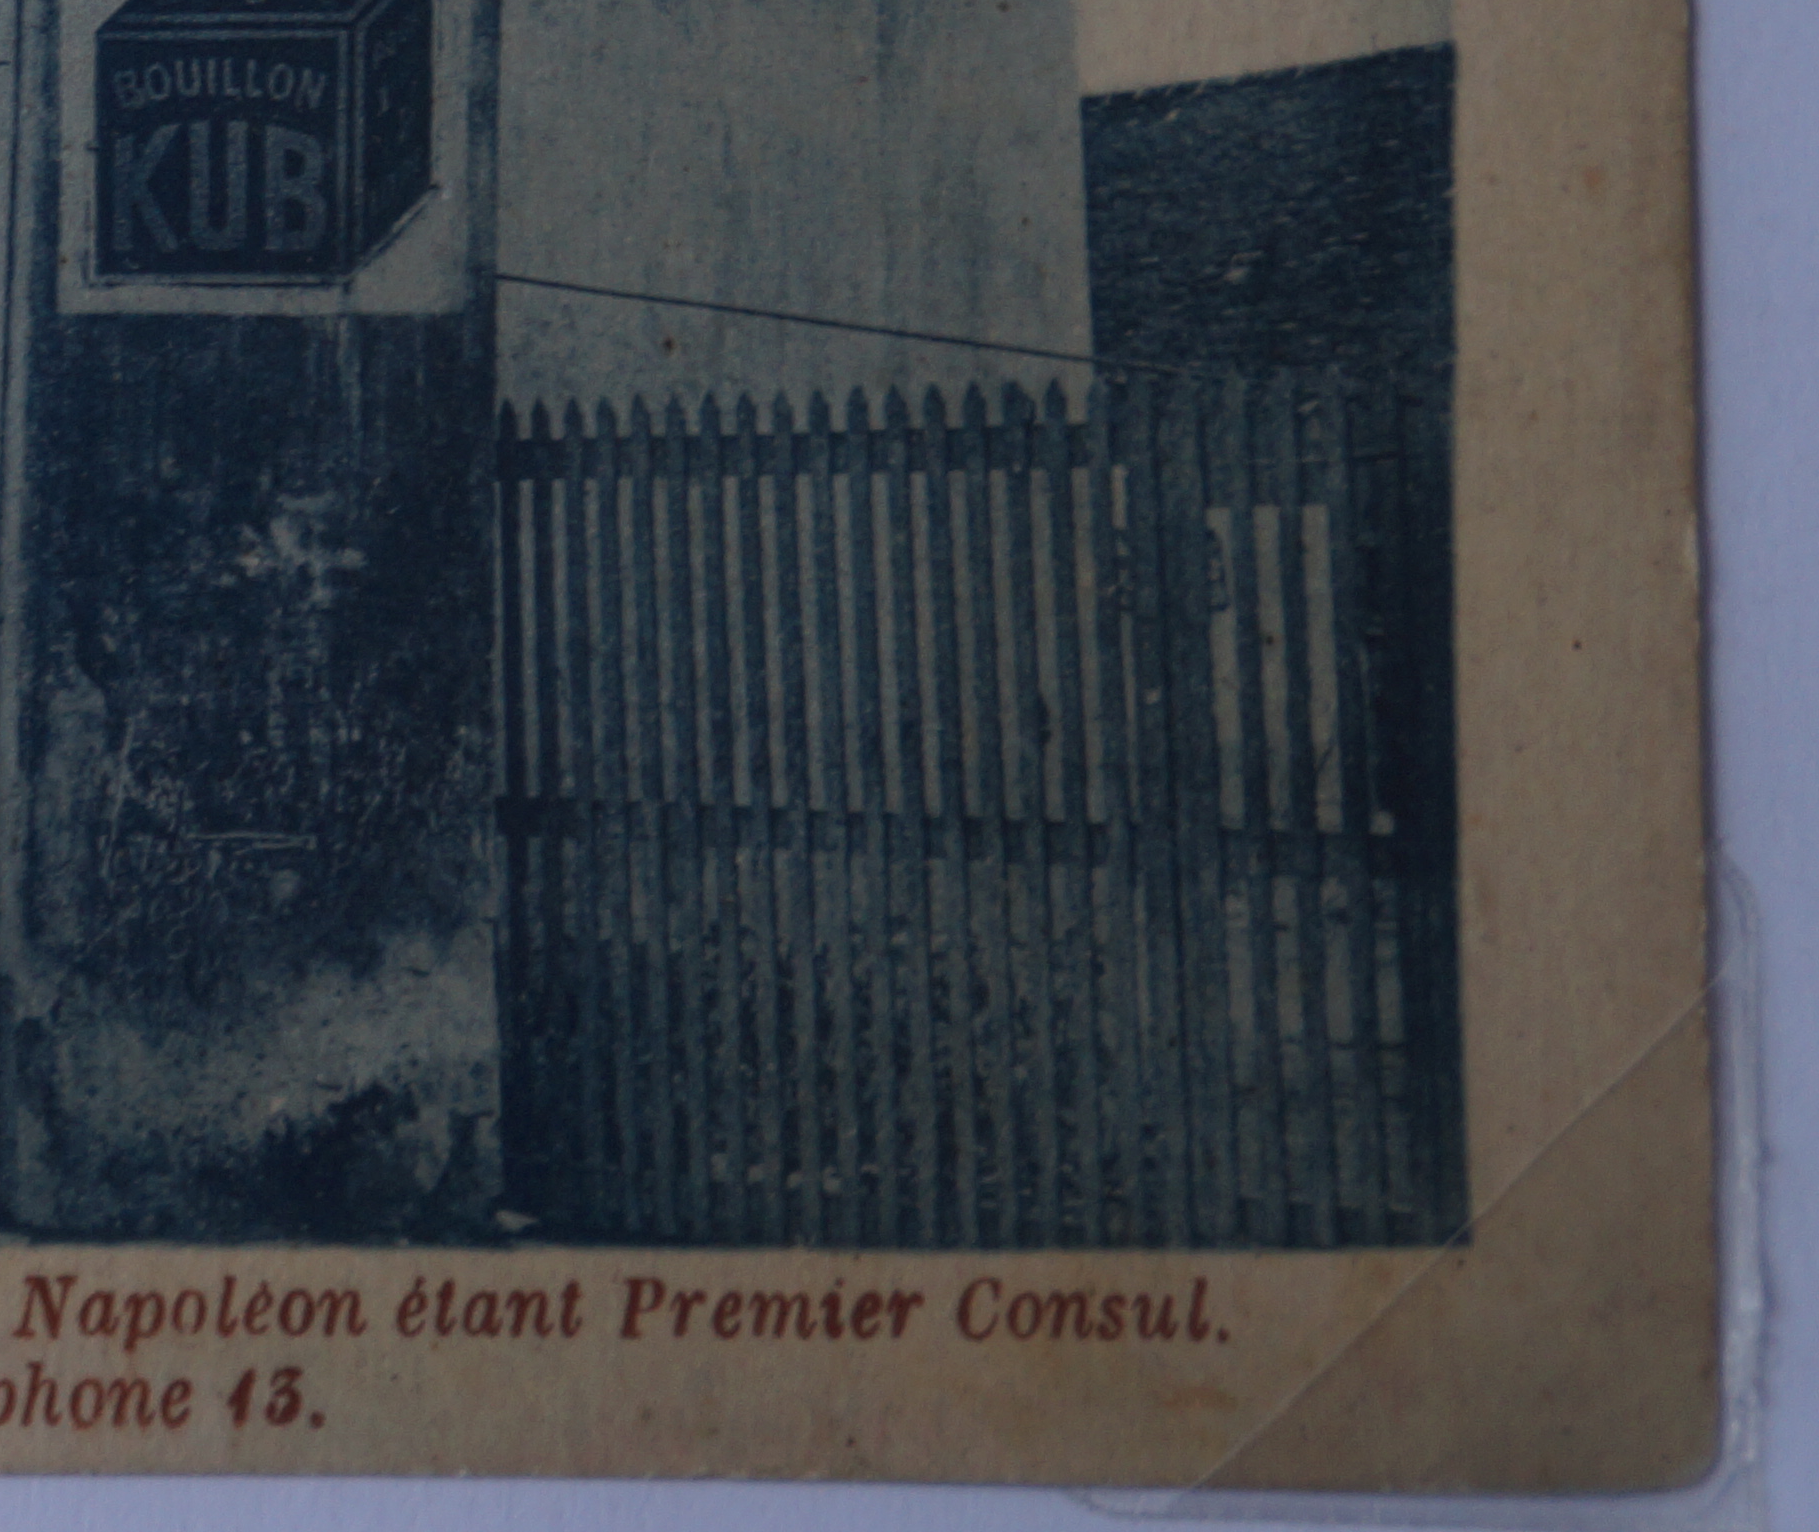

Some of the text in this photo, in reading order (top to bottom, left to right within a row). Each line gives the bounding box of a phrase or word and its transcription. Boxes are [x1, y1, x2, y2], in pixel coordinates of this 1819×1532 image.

[112, 55, 327, 110] BOUILLON
[112, 120, 329, 253] KUB
[395, 1275, 583, 1339] étant
[619, 1276, 925, 1342] Premier
[955, 1276, 1231, 1344] Consul.
[226, 1364, 326, 1430] 13.
